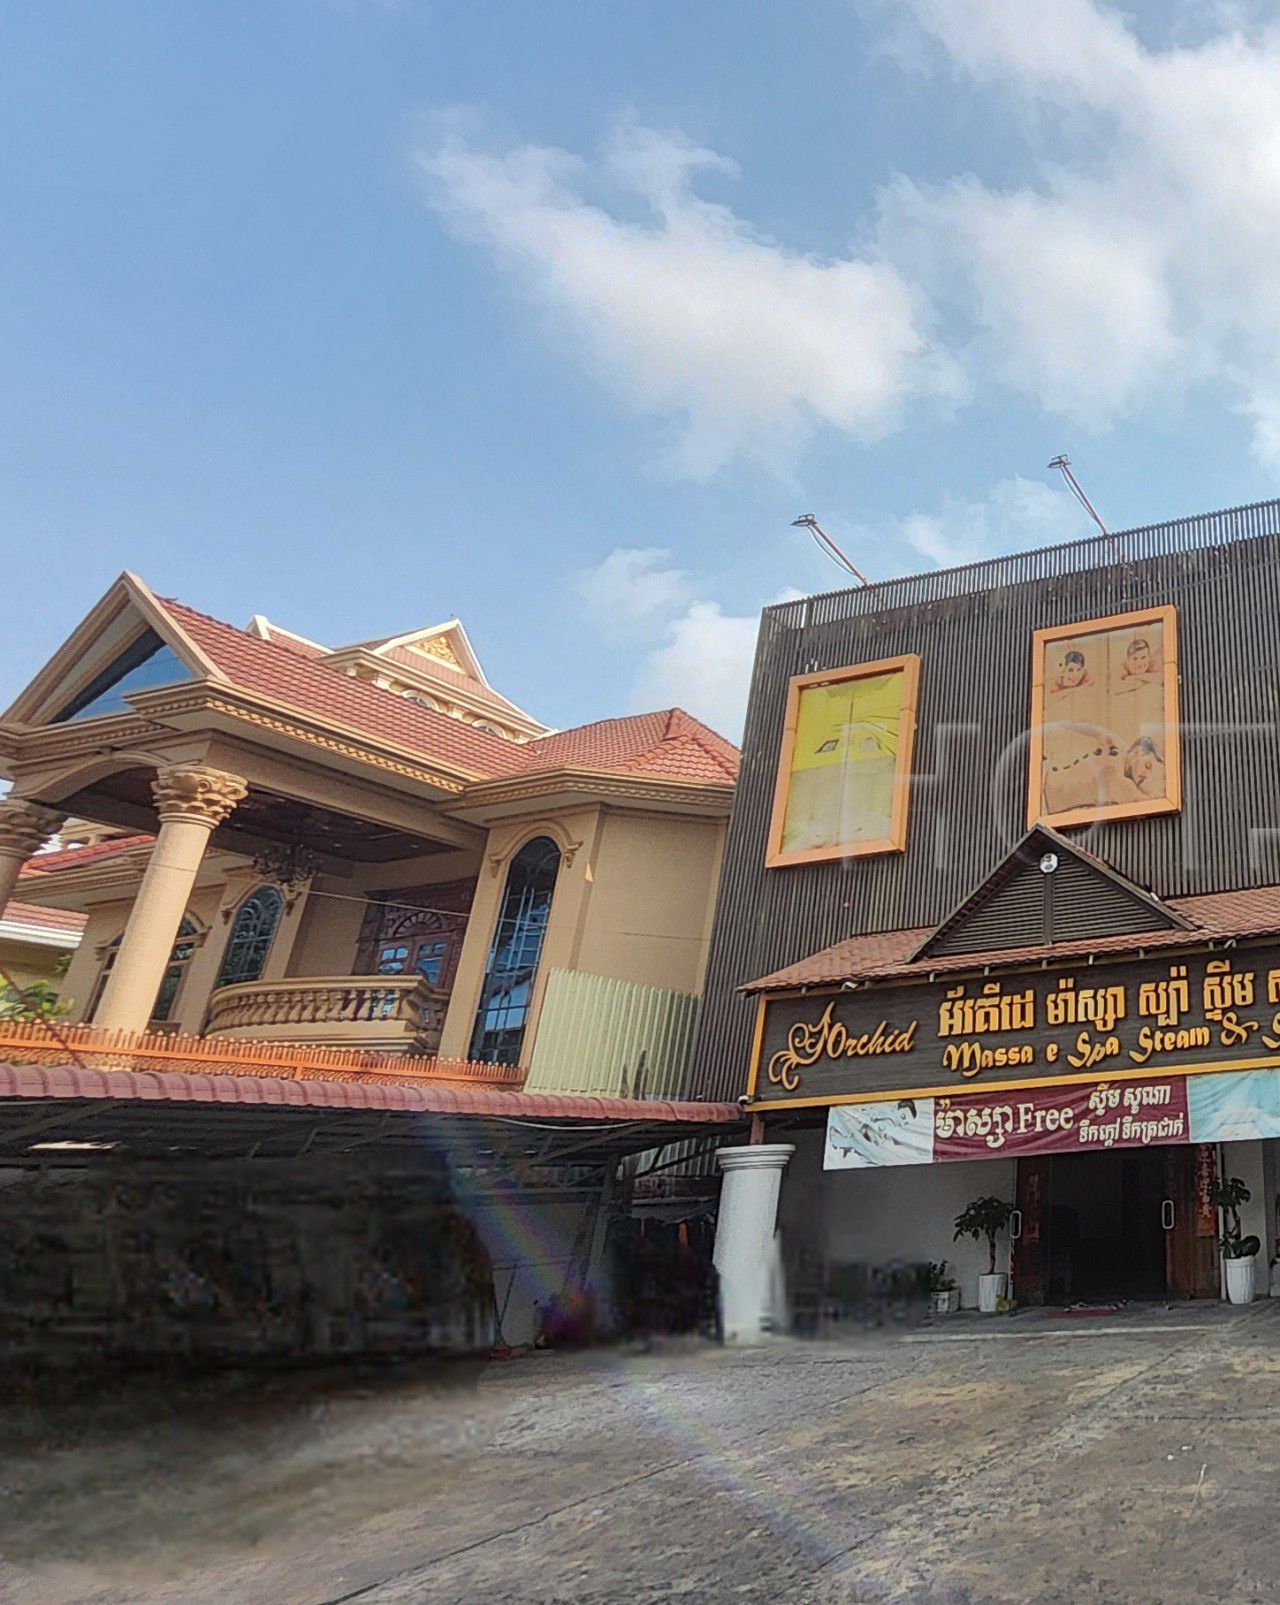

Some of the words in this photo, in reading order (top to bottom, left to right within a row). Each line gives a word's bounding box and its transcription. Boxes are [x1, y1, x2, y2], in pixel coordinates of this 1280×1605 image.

[826, 1020, 918, 1058] Orchid
[1066, 1031, 1120, 1069] Spa
[1128, 1026, 1211, 1063] Steam
[1220, 1012, 1260, 1046] &
[1016, 1102, 1075, 1135] Free
